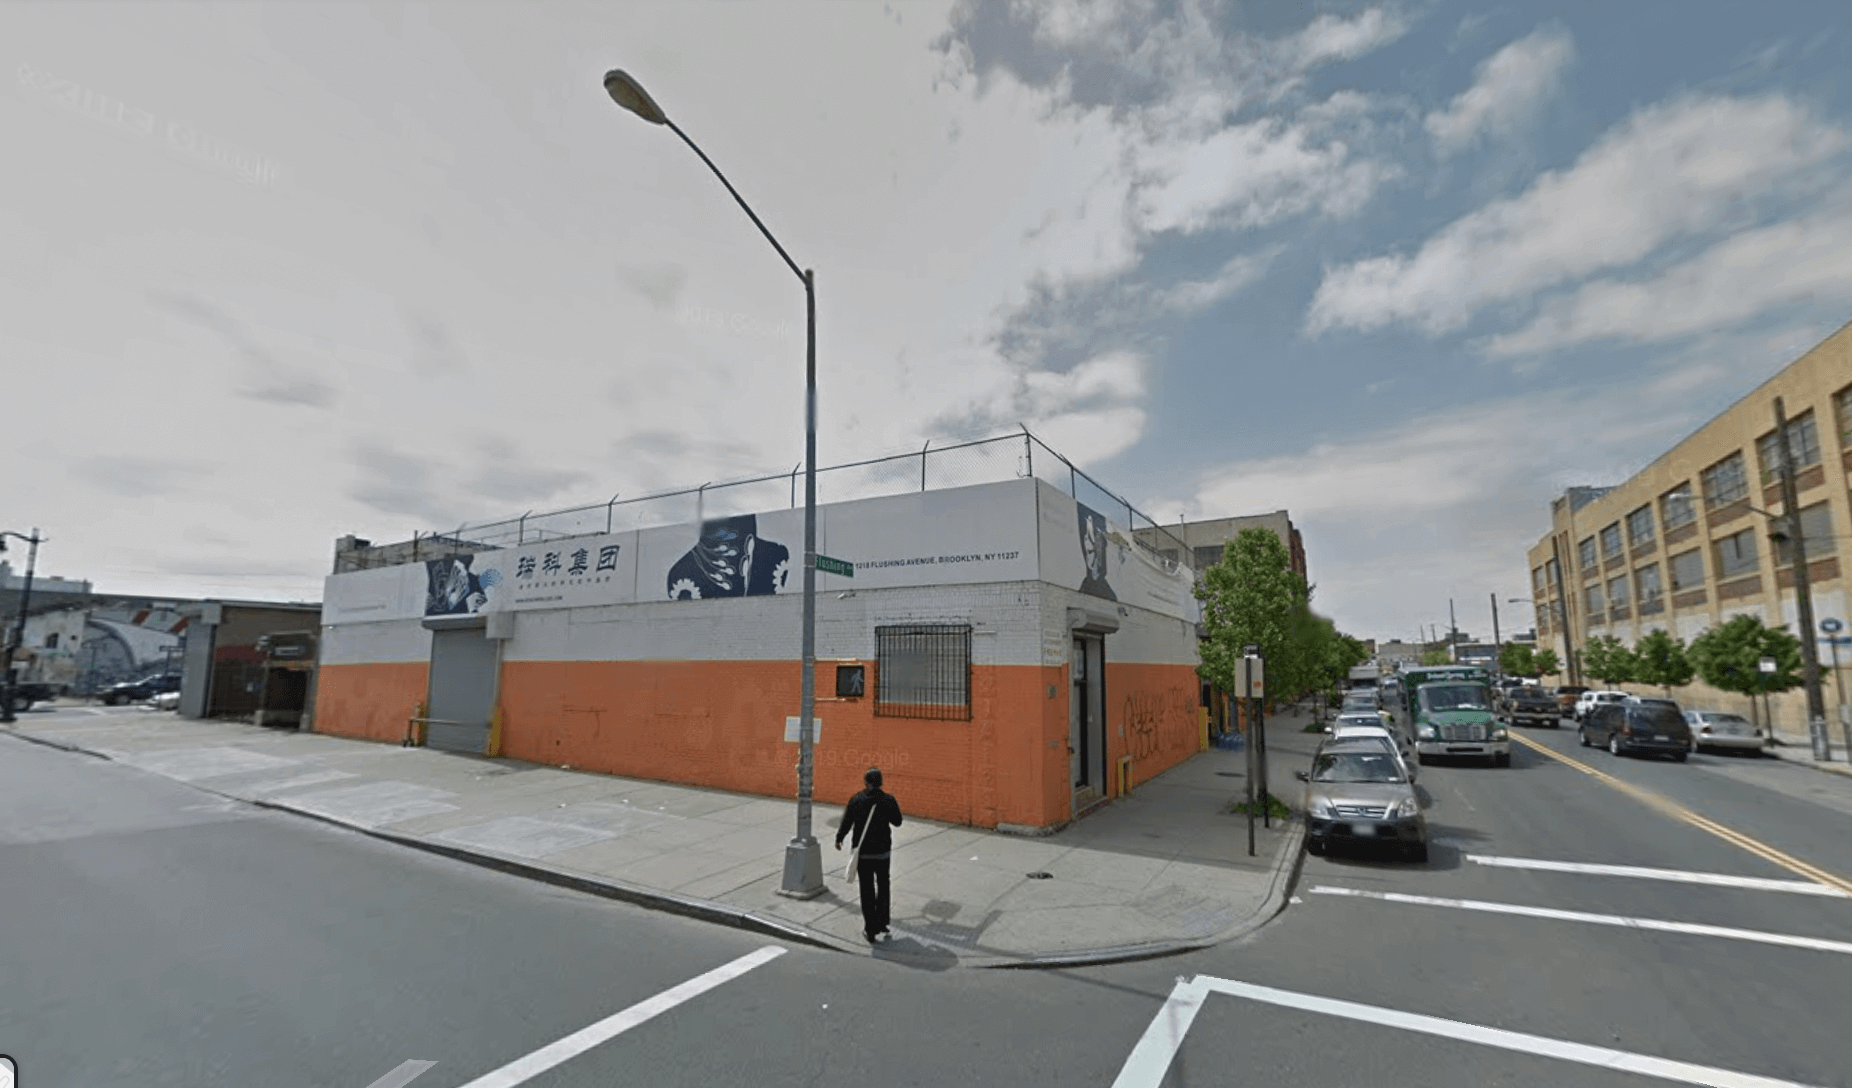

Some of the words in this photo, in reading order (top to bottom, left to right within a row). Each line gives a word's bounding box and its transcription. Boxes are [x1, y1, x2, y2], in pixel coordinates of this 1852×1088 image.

[516, 545, 621, 577] 瑞科集团
[871, 560, 905, 568] FLUSHING
[997, 551, 1020, 559] 11237
